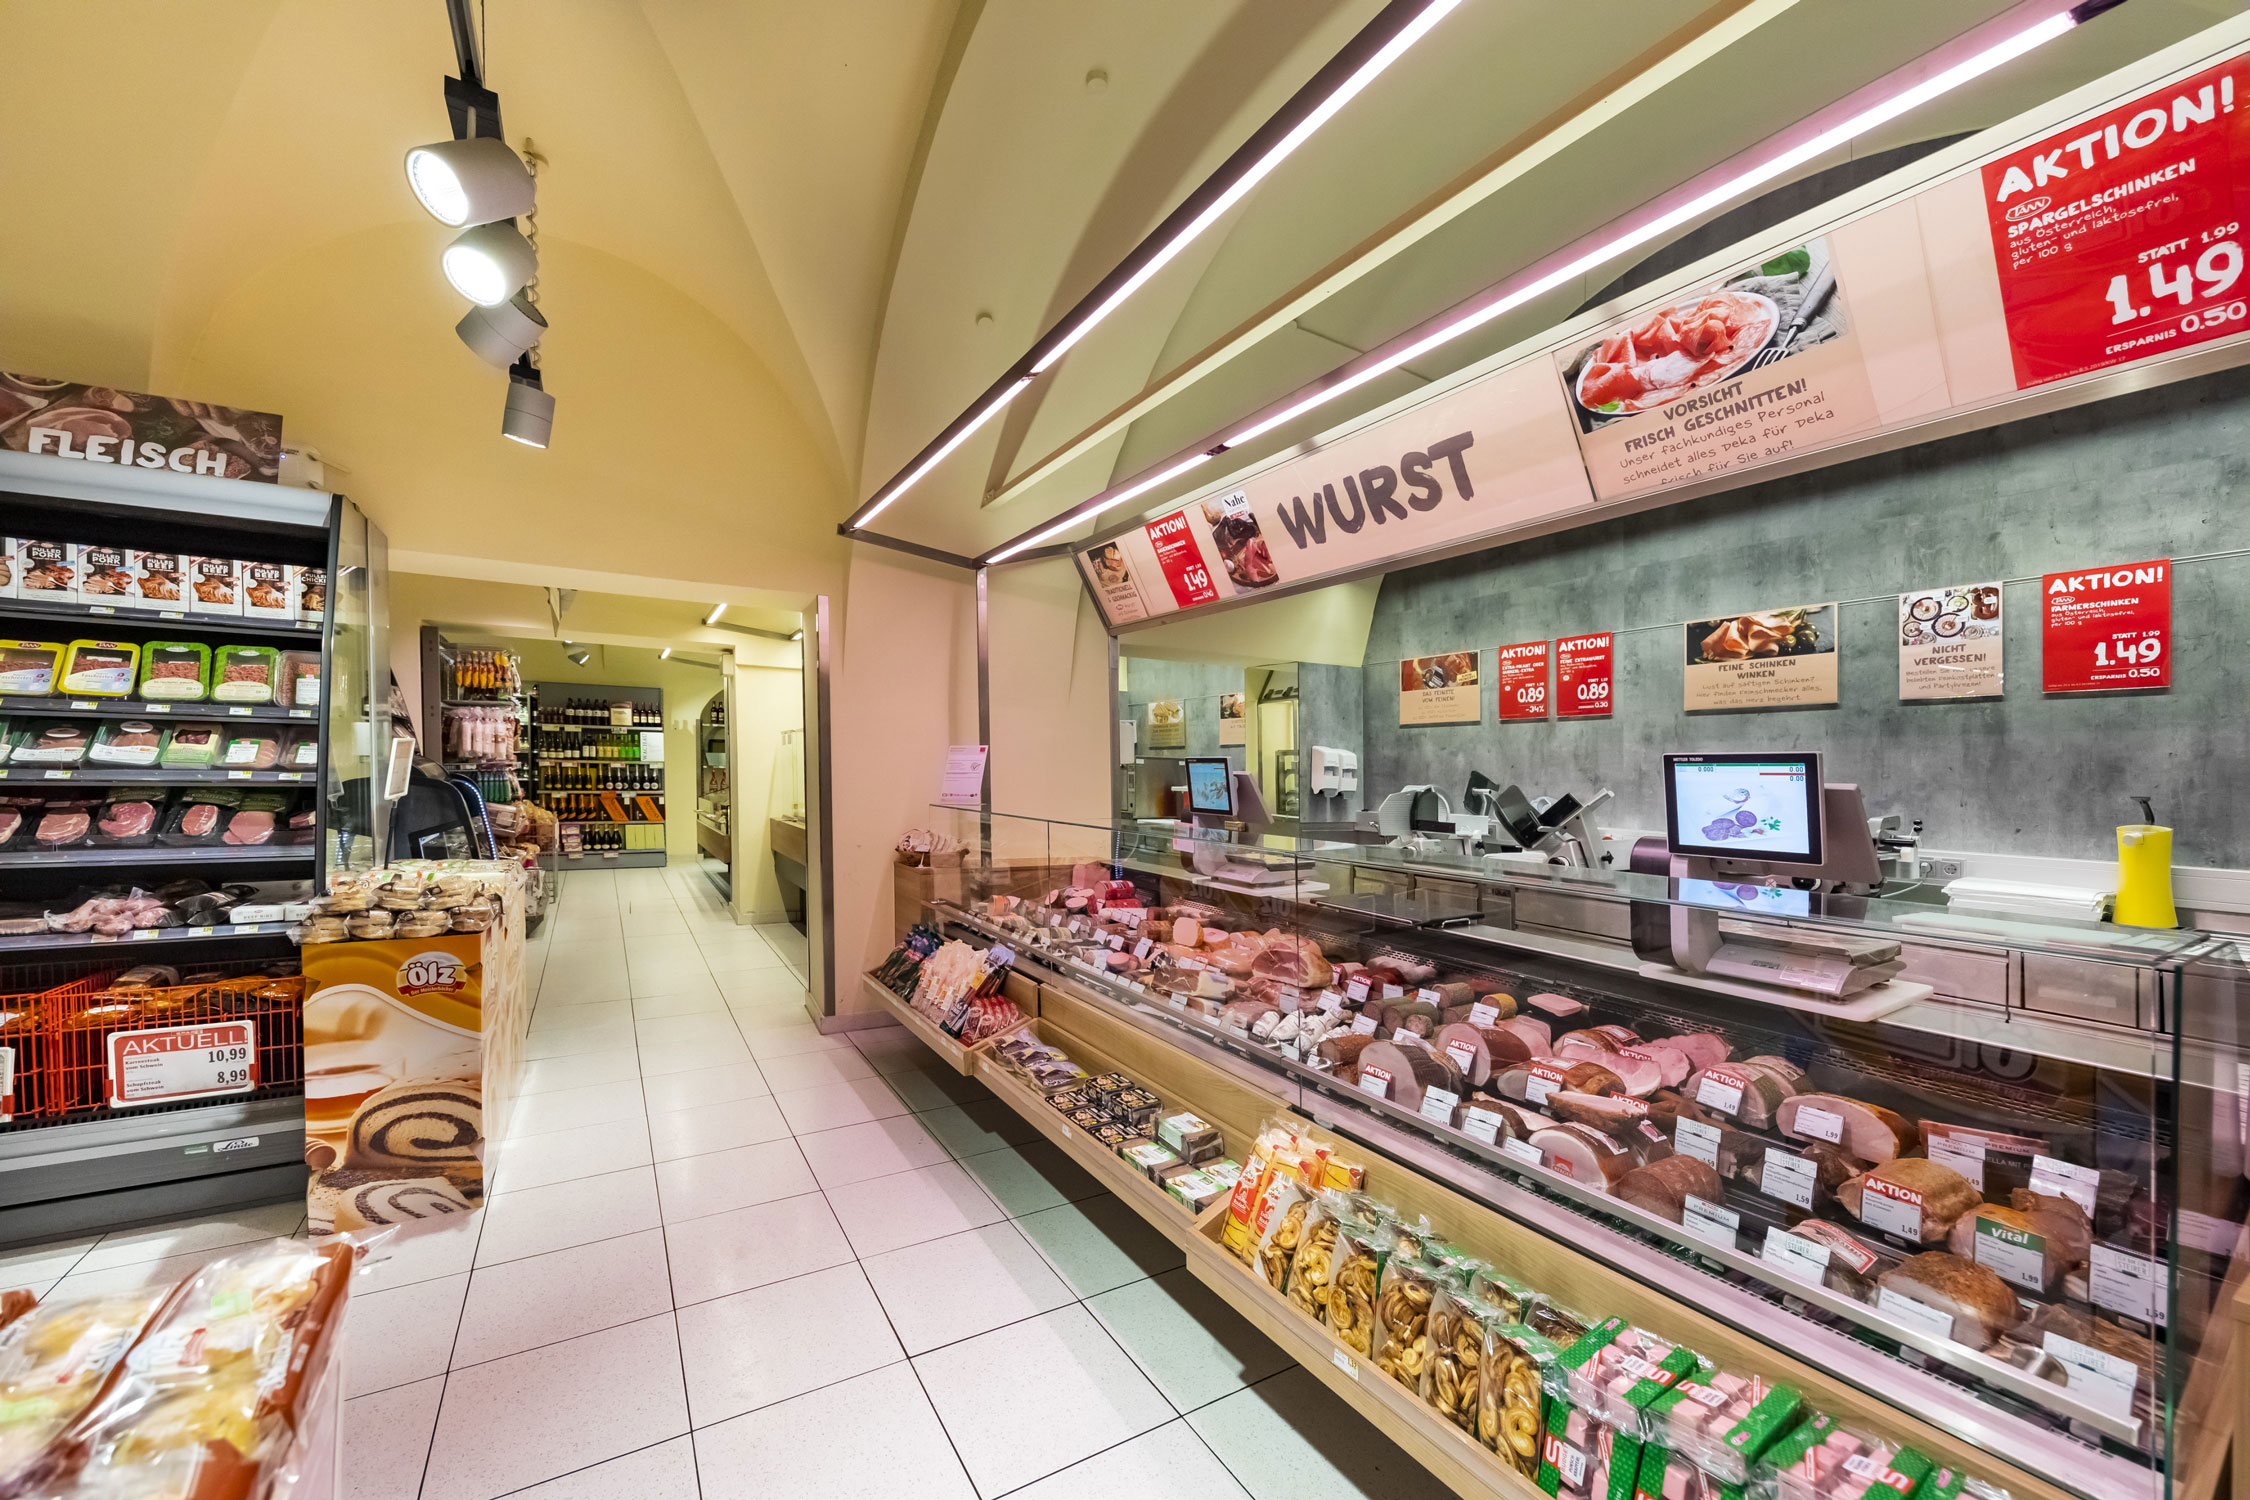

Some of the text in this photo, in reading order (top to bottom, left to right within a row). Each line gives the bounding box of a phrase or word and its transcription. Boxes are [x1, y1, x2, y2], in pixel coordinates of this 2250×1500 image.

[1996, 76, 2234, 202] AKTION!
[2007, 158, 2195, 238] SPARGELSCHINKEN
[2010, 205, 2117, 249] aus Österreich,
[2011, 193, 2179, 260] gluten- und laktosefrei,
[2138, 222, 2239, 263] STATT 1.99
[2013, 243, 2073, 270] per 100 g
[2105, 241, 2245, 325] 1.49
[2105, 301, 2247, 355] ERSPARNIS 0.50
[1663, 381, 1744, 421] VORSICHT
[1624, 378, 1807, 453] FRISCH GESCHNITTEN!
[1620, 391, 1825, 469] Unser fachkundiges Personal
[28, 426, 228, 477] FLEISCH
[1623, 457, 1682, 485] schneidet
[1687, 447, 1717, 463] alles
[1762, 426, 1788, 441] für
[1708, 460, 1732, 475] für
[1736, 451, 1758, 465] Sie
[1764, 440, 1794, 456] auf!
[1276, 430, 1475, 550] WURST
[1149, 516, 1187, 540] AKTION!
[32, 547, 62, 555] PULLED
[32, 551, 62, 559] PORK
[92, 552, 121, 560] PULLED
[92, 557, 121, 565] PORK
[147, 562, 174, 570] BEEF
[1183, 569, 1208, 591] 1.49
[2048, 566, 2164, 595] AKTION!
[2051, 597, 2139, 613] FARMERSCHINKEN
[1559, 636, 1610, 653] AKTION!
[2112, 632, 2137, 640] STATT
[1501, 644, 1546, 660] AKTION!
[1932, 644, 1967, 655] NICHT
[2094, 638, 2161, 666] 1.49
[1718, 659, 1797, 673] FEINE SCHINKEN
[1914, 653, 1987, 666] VERGESSEN!
[1737, 670, 1776, 680] WINKEN
[2128, 667, 2160, 678] 0.50
[1517, 687, 1545, 703] 0.89
[1577, 682, 1609, 700] 0.89
[1525, 705, 1545, 713] -34%
[406, 960, 457, 988] Ölz
[123, 1029, 249, 1055] AKTUELL!
[1450, 1039, 1477, 1053] AKTION
[208, 1047, 247, 1063] 10,99
[217, 1069, 247, 1085] 8,99
[1365, 1065, 1392, 1081] AKTION
[1531, 1067, 1563, 1082] AKTION
[1704, 1070, 1745, 1089] AKTION
[218, 1140, 253, 1152] Linde
[1985, 1142, 2030, 1154] PREMIUM
[1865, 1178, 1922, 1205] AKTION
[1693, 1203, 1730, 1223] PREMIUM
[1991, 1227, 2029, 1244] Vital
